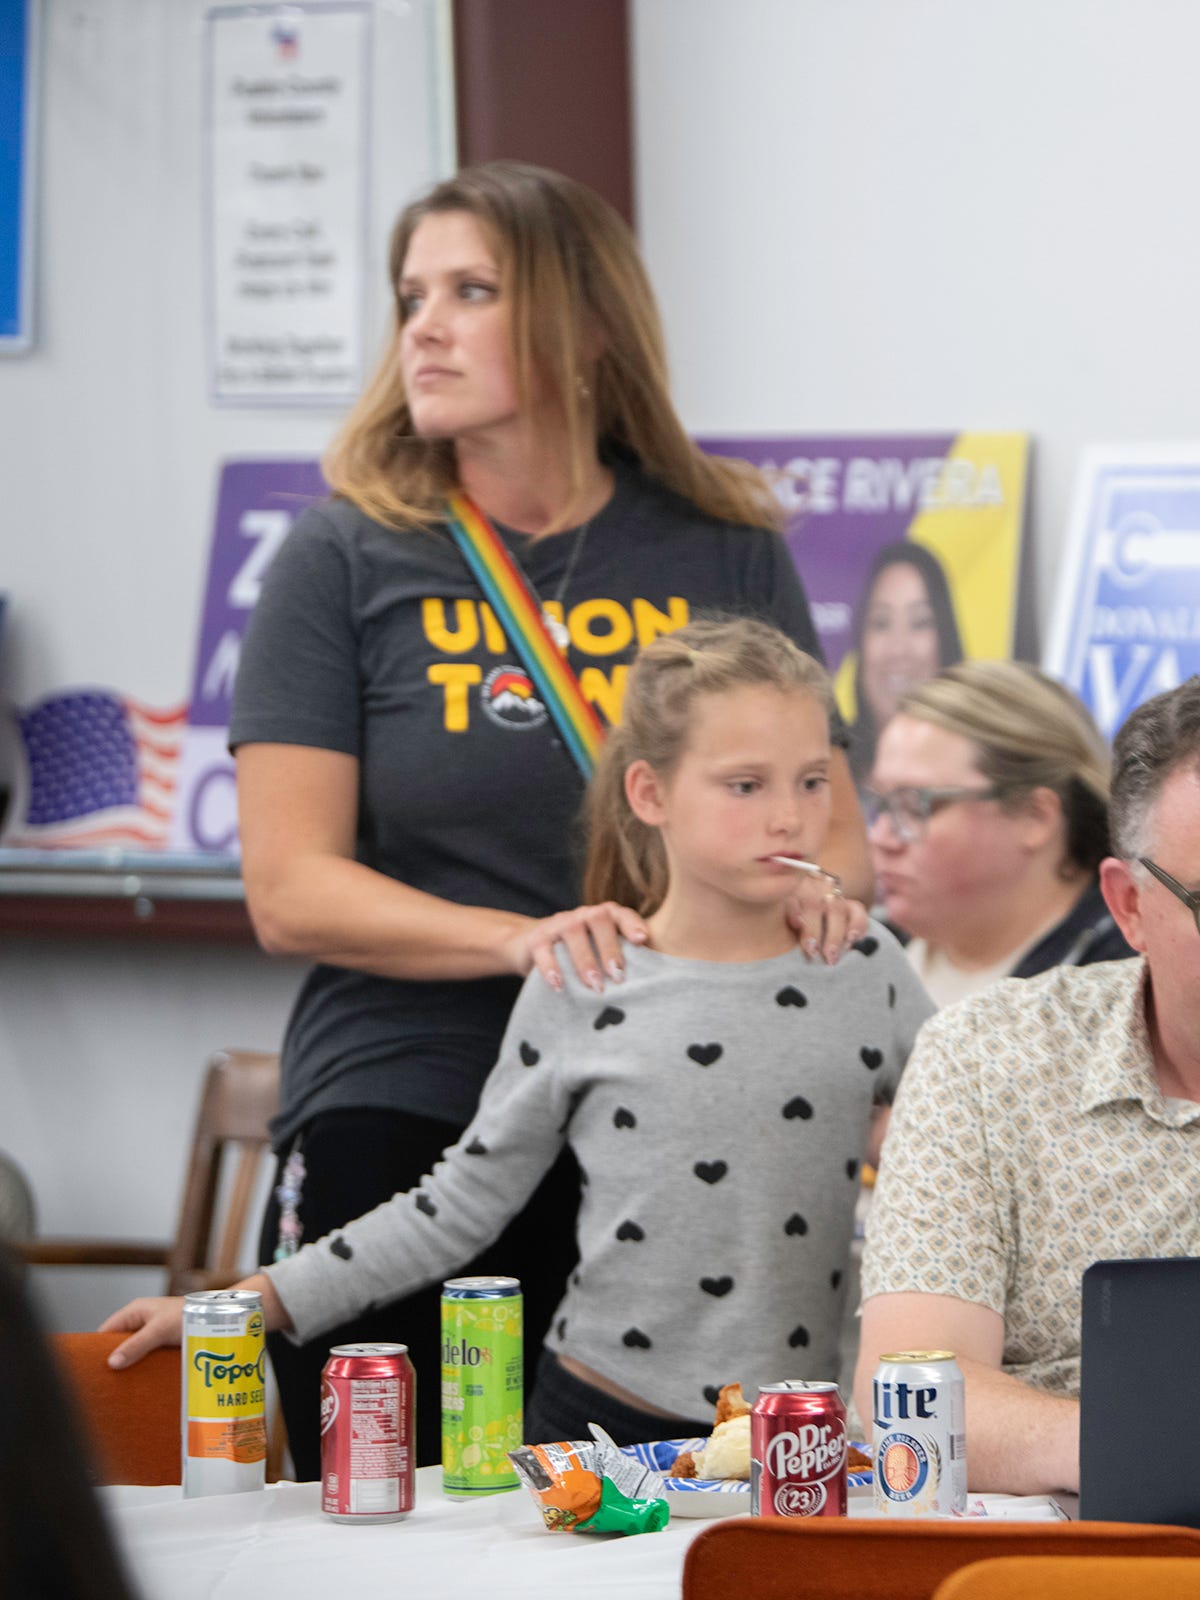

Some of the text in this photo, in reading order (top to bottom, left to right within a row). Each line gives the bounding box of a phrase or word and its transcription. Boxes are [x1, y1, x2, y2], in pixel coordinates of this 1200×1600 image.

[846, 457, 1004, 512] RIVERA
[194, 1350, 257, 1387] Topo
[440, 1338, 481, 1366] delo
[217, 1392, 247, 1407] HARD
[873, 1379, 937, 1430] Lite
[767, 1431, 845, 1479] Pepper
[799, 1424, 832, 1453] Dr
[789, 1490, 811, 1509] 23
